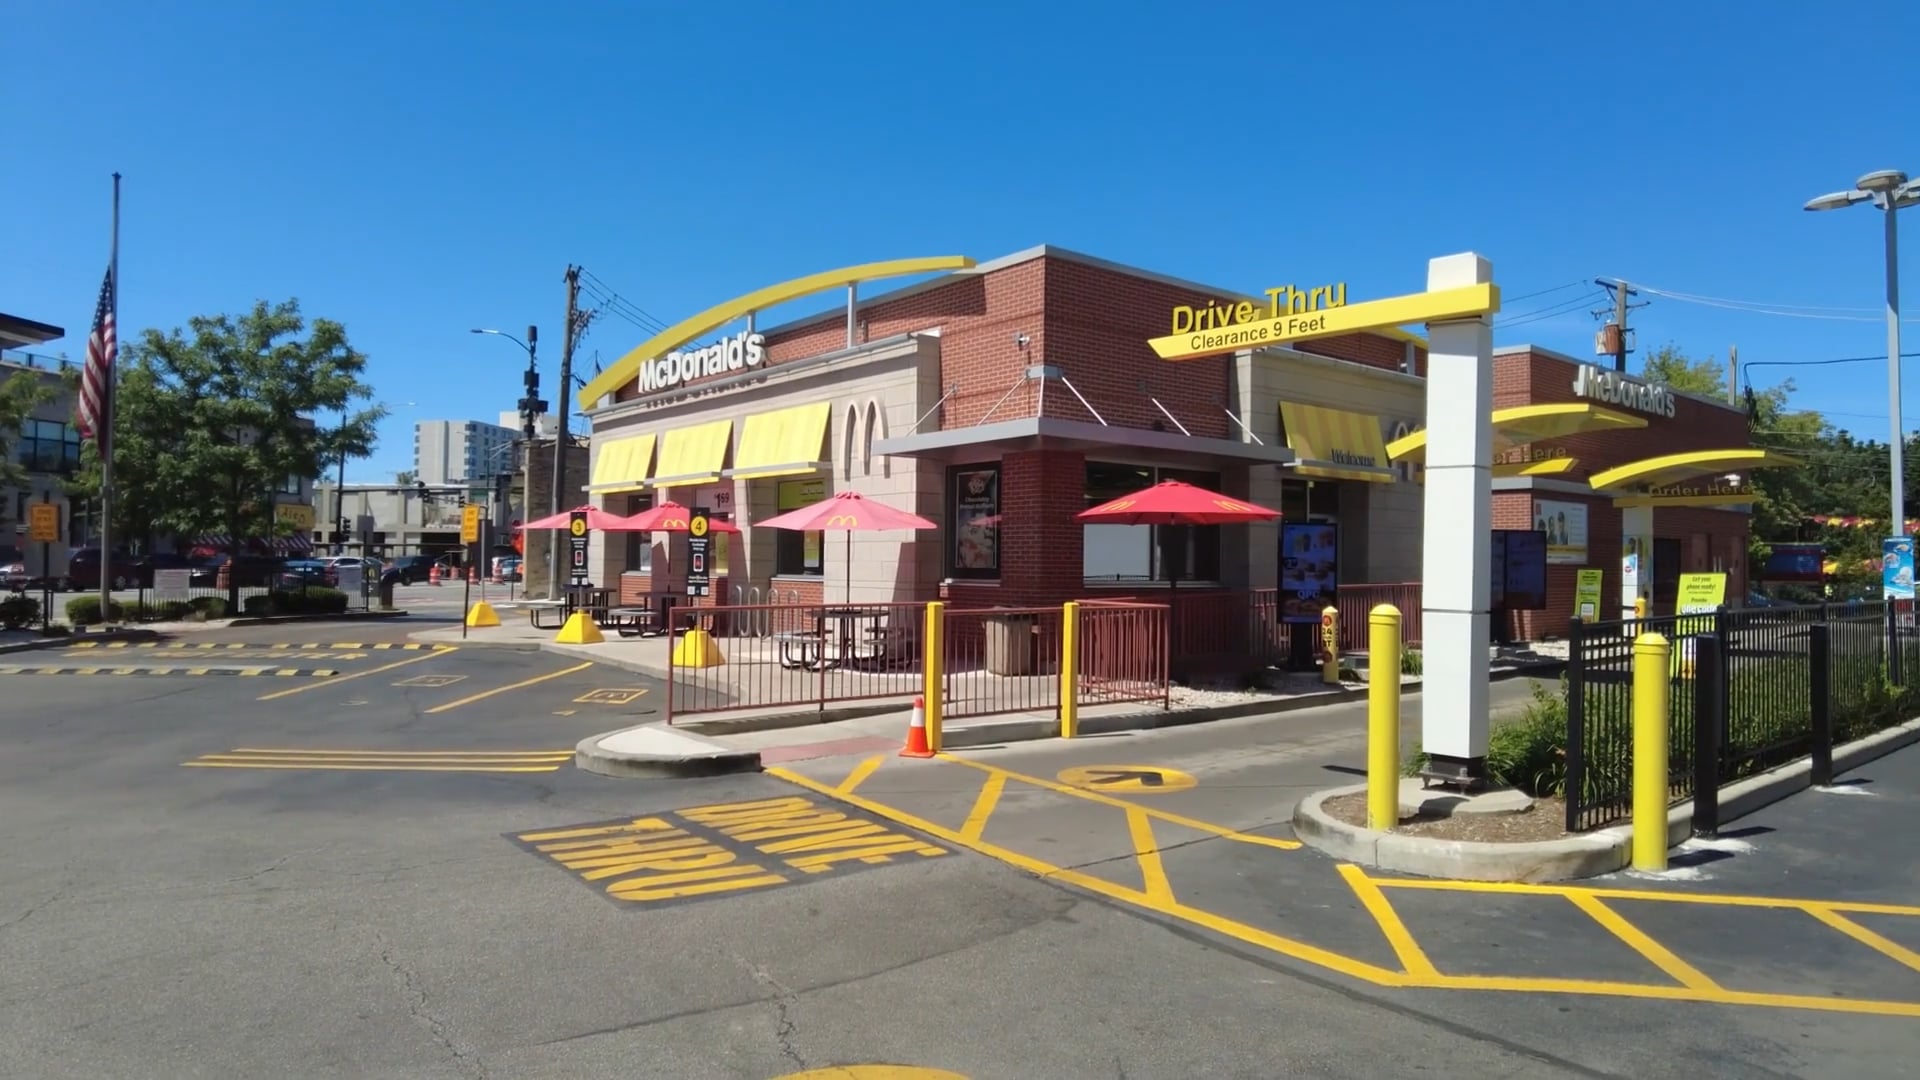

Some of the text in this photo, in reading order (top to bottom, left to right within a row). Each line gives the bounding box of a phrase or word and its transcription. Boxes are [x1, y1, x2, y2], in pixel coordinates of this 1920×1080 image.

[1172, 282, 1346, 336] Drive Thru
[1191, 314, 1326, 350] Clearance 9 Feet
[638, 331, 765, 394] McDonald's
[1649, 484, 1699, 497] Order
[517, 817, 790, 901] THRU
[674, 797, 949, 874] DRIVE
